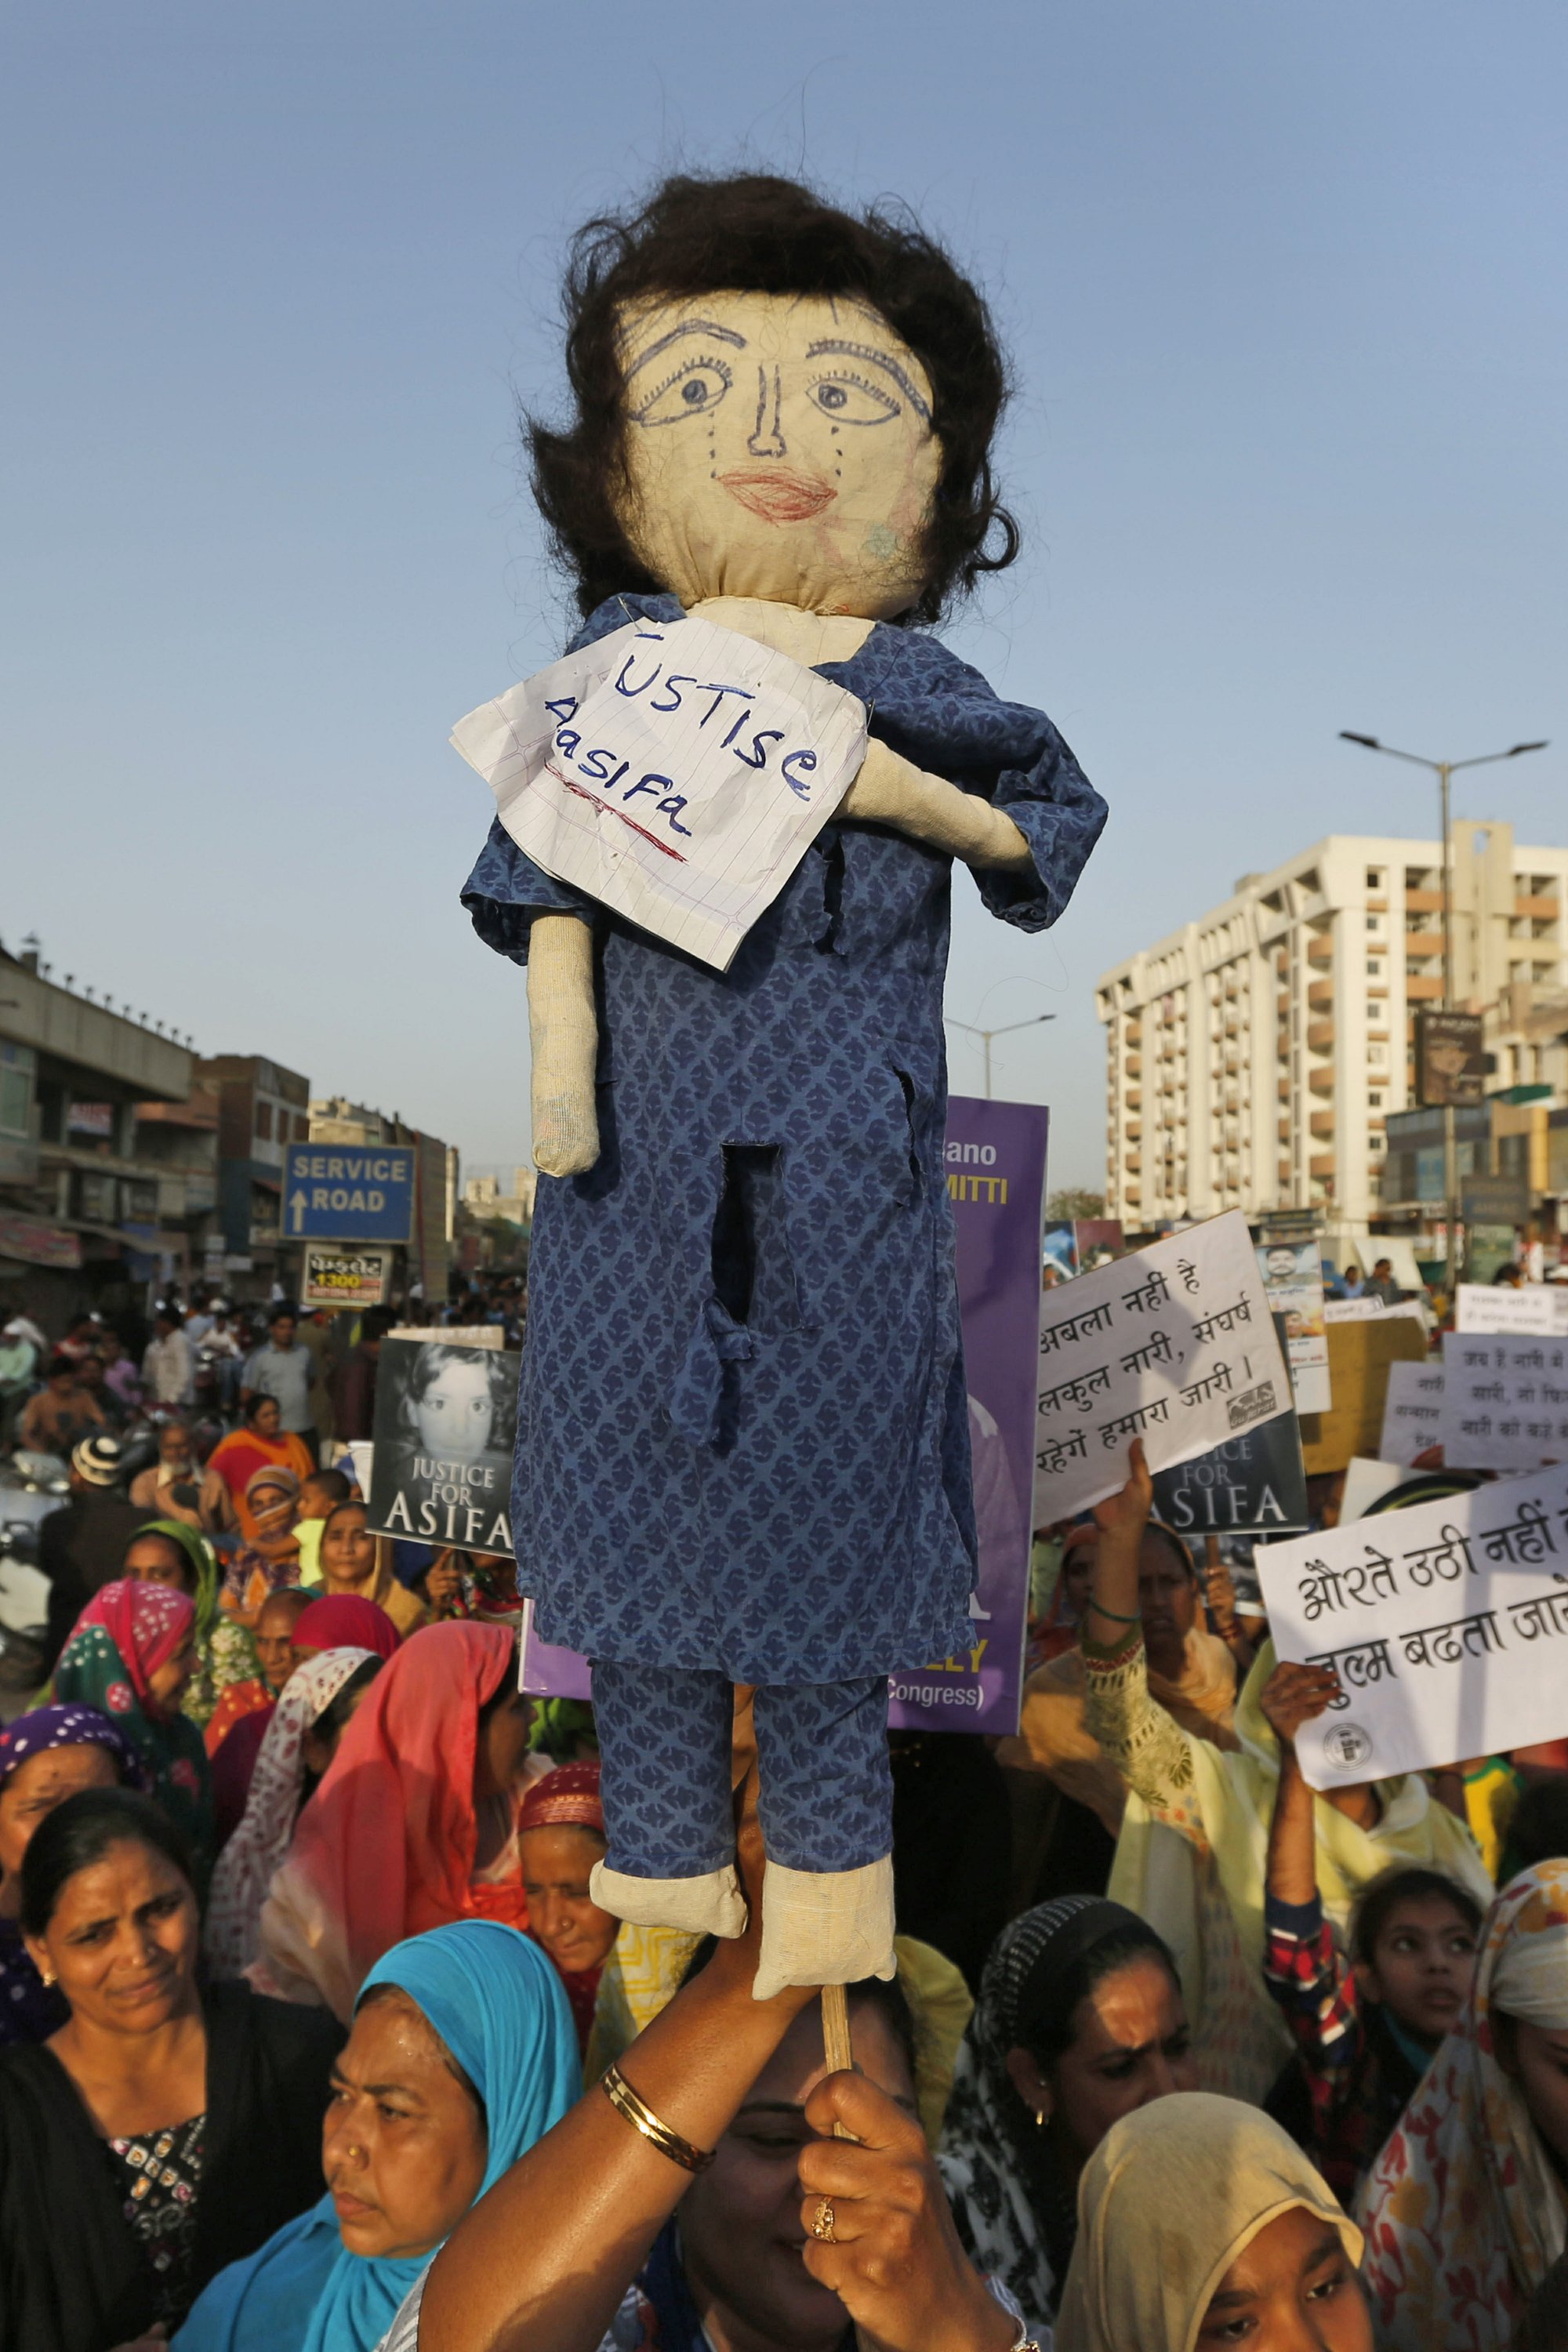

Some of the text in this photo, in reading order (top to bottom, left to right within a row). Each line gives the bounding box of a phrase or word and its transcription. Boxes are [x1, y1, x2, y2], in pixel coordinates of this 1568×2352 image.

[292, 1155, 407, 1181] SERVICE
[942, 1141, 996, 1166] ano
[312, 1187, 385, 1212] ROAD
[317, 1273, 361, 1290] 1300
[1040, 1302, 1113, 1354] अबला
[1178, 1259, 1200, 1294] है
[1192, 1291, 1252, 1344] संघर्ष
[1098, 1398, 1170, 1450] हमारा
[1179, 1362, 1233, 1408] जारी
[412, 1457, 495, 1489] JUSTICE
[1183, 1465, 1234, 1486] FOR
[430, 1483, 474, 1508] FOR
[383, 1490, 514, 1550] ASIFA
[1299, 1545, 1399, 1622] औरते
[1403, 1523, 1479, 1588] उठी
[1480, 1498, 1559, 1565] नहीं
